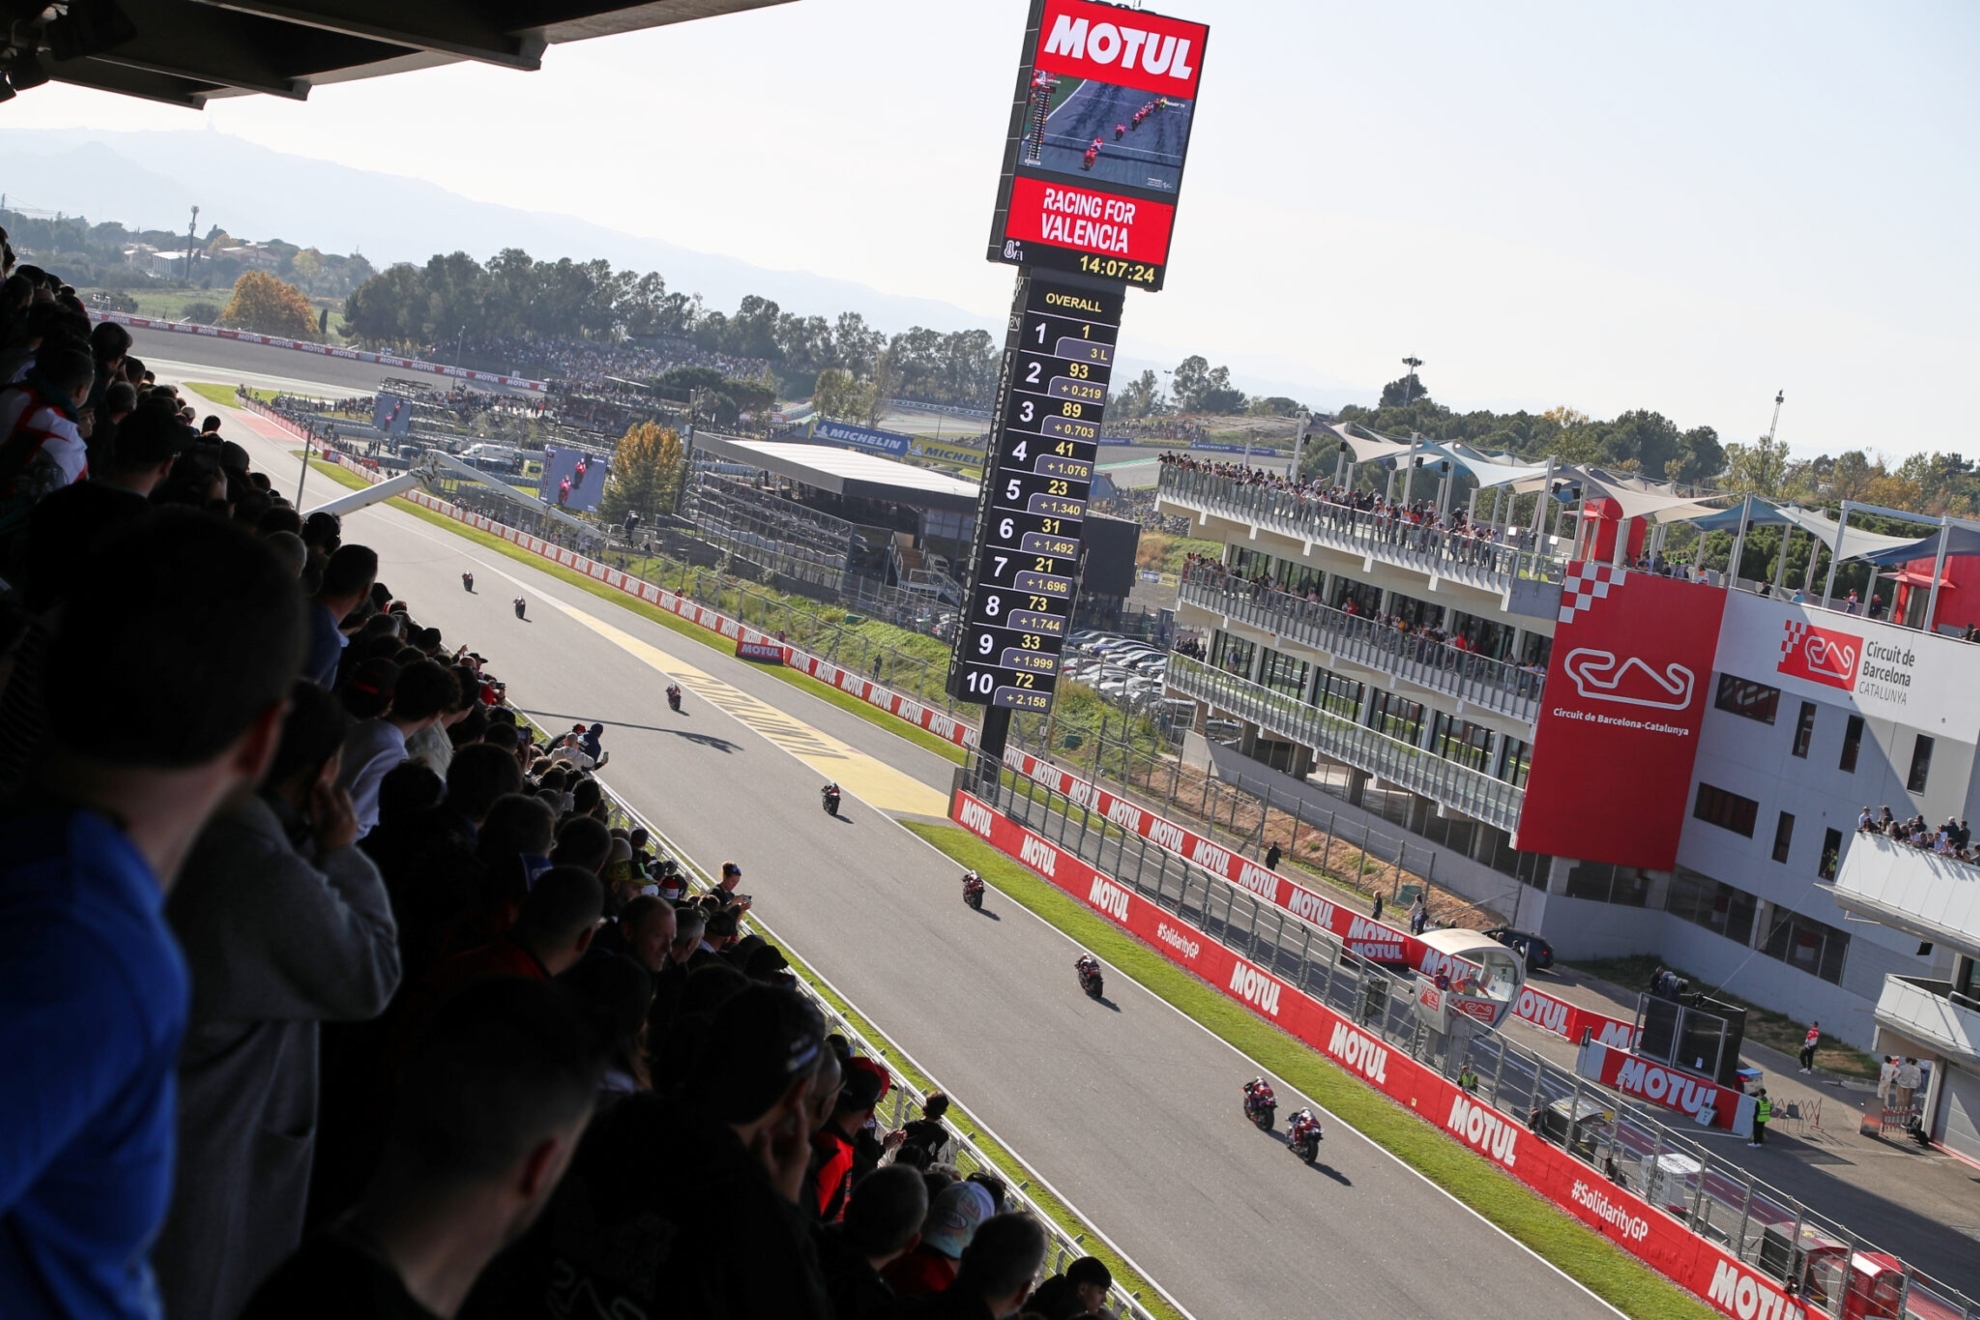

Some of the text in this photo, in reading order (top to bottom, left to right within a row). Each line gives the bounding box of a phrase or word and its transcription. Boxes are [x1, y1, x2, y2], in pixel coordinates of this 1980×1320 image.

[1044, 14, 1192, 80] MOTUL
[1043, 187, 1136, 225] RACING FOR
[1041, 213, 1129, 254] VALENCIA
[1080, 255, 1155, 283] 14:07:24
[1045, 292, 1102, 313] OVERALL
[1035, 322, 1090, 344] 1 1
[332, 349, 356, 359] MOTUL
[379, 357, 404, 367] MOTUL
[1090, 348, 1108, 360] 3 L
[1025, 362, 1089, 384] 2 93
[1071, 385, 1102, 399] 0.219
[1019, 401, 1082, 422] 3 89
[830, 428, 902, 450] MICHELIN
[1064, 424, 1095, 438] 0.703
[1012, 441, 1074, 461] 4 41
[1058, 463, 1088, 477] 1.076
[1006, 479, 1068, 500] 5 23
[1051, 502, 1081, 516] 1.340
[999, 518, 1060, 539] 6 31
[1044, 540, 1074, 555] 1.492
[994, 556, 1054, 577] 7 21
[1037, 579, 1068, 593] 1.696
[985, 595, 1048, 616] 8 73
[1031, 618, 1060, 631] 1.744
[741, 644, 779, 657] MOTUL
[978, 634, 1041, 655] 9 33
[1866, 641, 1915, 667] Circuit de
[1024, 656, 1054, 669] 1.999
[966, 671, 1034, 694] 10 72
[1862, 661, 1911, 687] Barcelona
[1016, 694, 1047, 708] 2.158
[1858, 681, 1907, 706] CATALUNYA
[1553, 708, 1689, 737] Circuit de Barcelona-Catalunya
[790, 650, 812, 673] MOTUL
[814, 661, 838, 685] MOTUL
[841, 672, 865, 697] MOTUL
[868, 684, 894, 711] MOTUL
[898, 699, 924, 726] MOTUL
[929, 714, 957, 741] MOTUL
[1003, 749, 1026, 773] OTUL
[1031, 761, 1062, 790] MOTUL
[1108, 798, 1141, 832] MOTUL
[1149, 818, 1185, 853] MOTUL
[1192, 840, 1230, 876] MOTUL
[1238, 862, 1279, 903] MOTUL
[1288, 887, 1335, 930] MOTUL
[1512, 990, 1568, 1034] OTUL
[1351, 942, 1403, 959] MOTUL
[960, 798, 992, 838] MOTUL
[1020, 834, 1057, 877] MOTUL
[1089, 875, 1130, 922] MOTUL
[1157, 922, 1199, 959] #SolidarityGP
[1229, 961, 1281, 1017] MOTUL
[1328, 1021, 1388, 1084] MOTUL
[1447, 1094, 1518, 1167] MOTUL
[1571, 1179, 1649, 1242] #SolidarityGP
